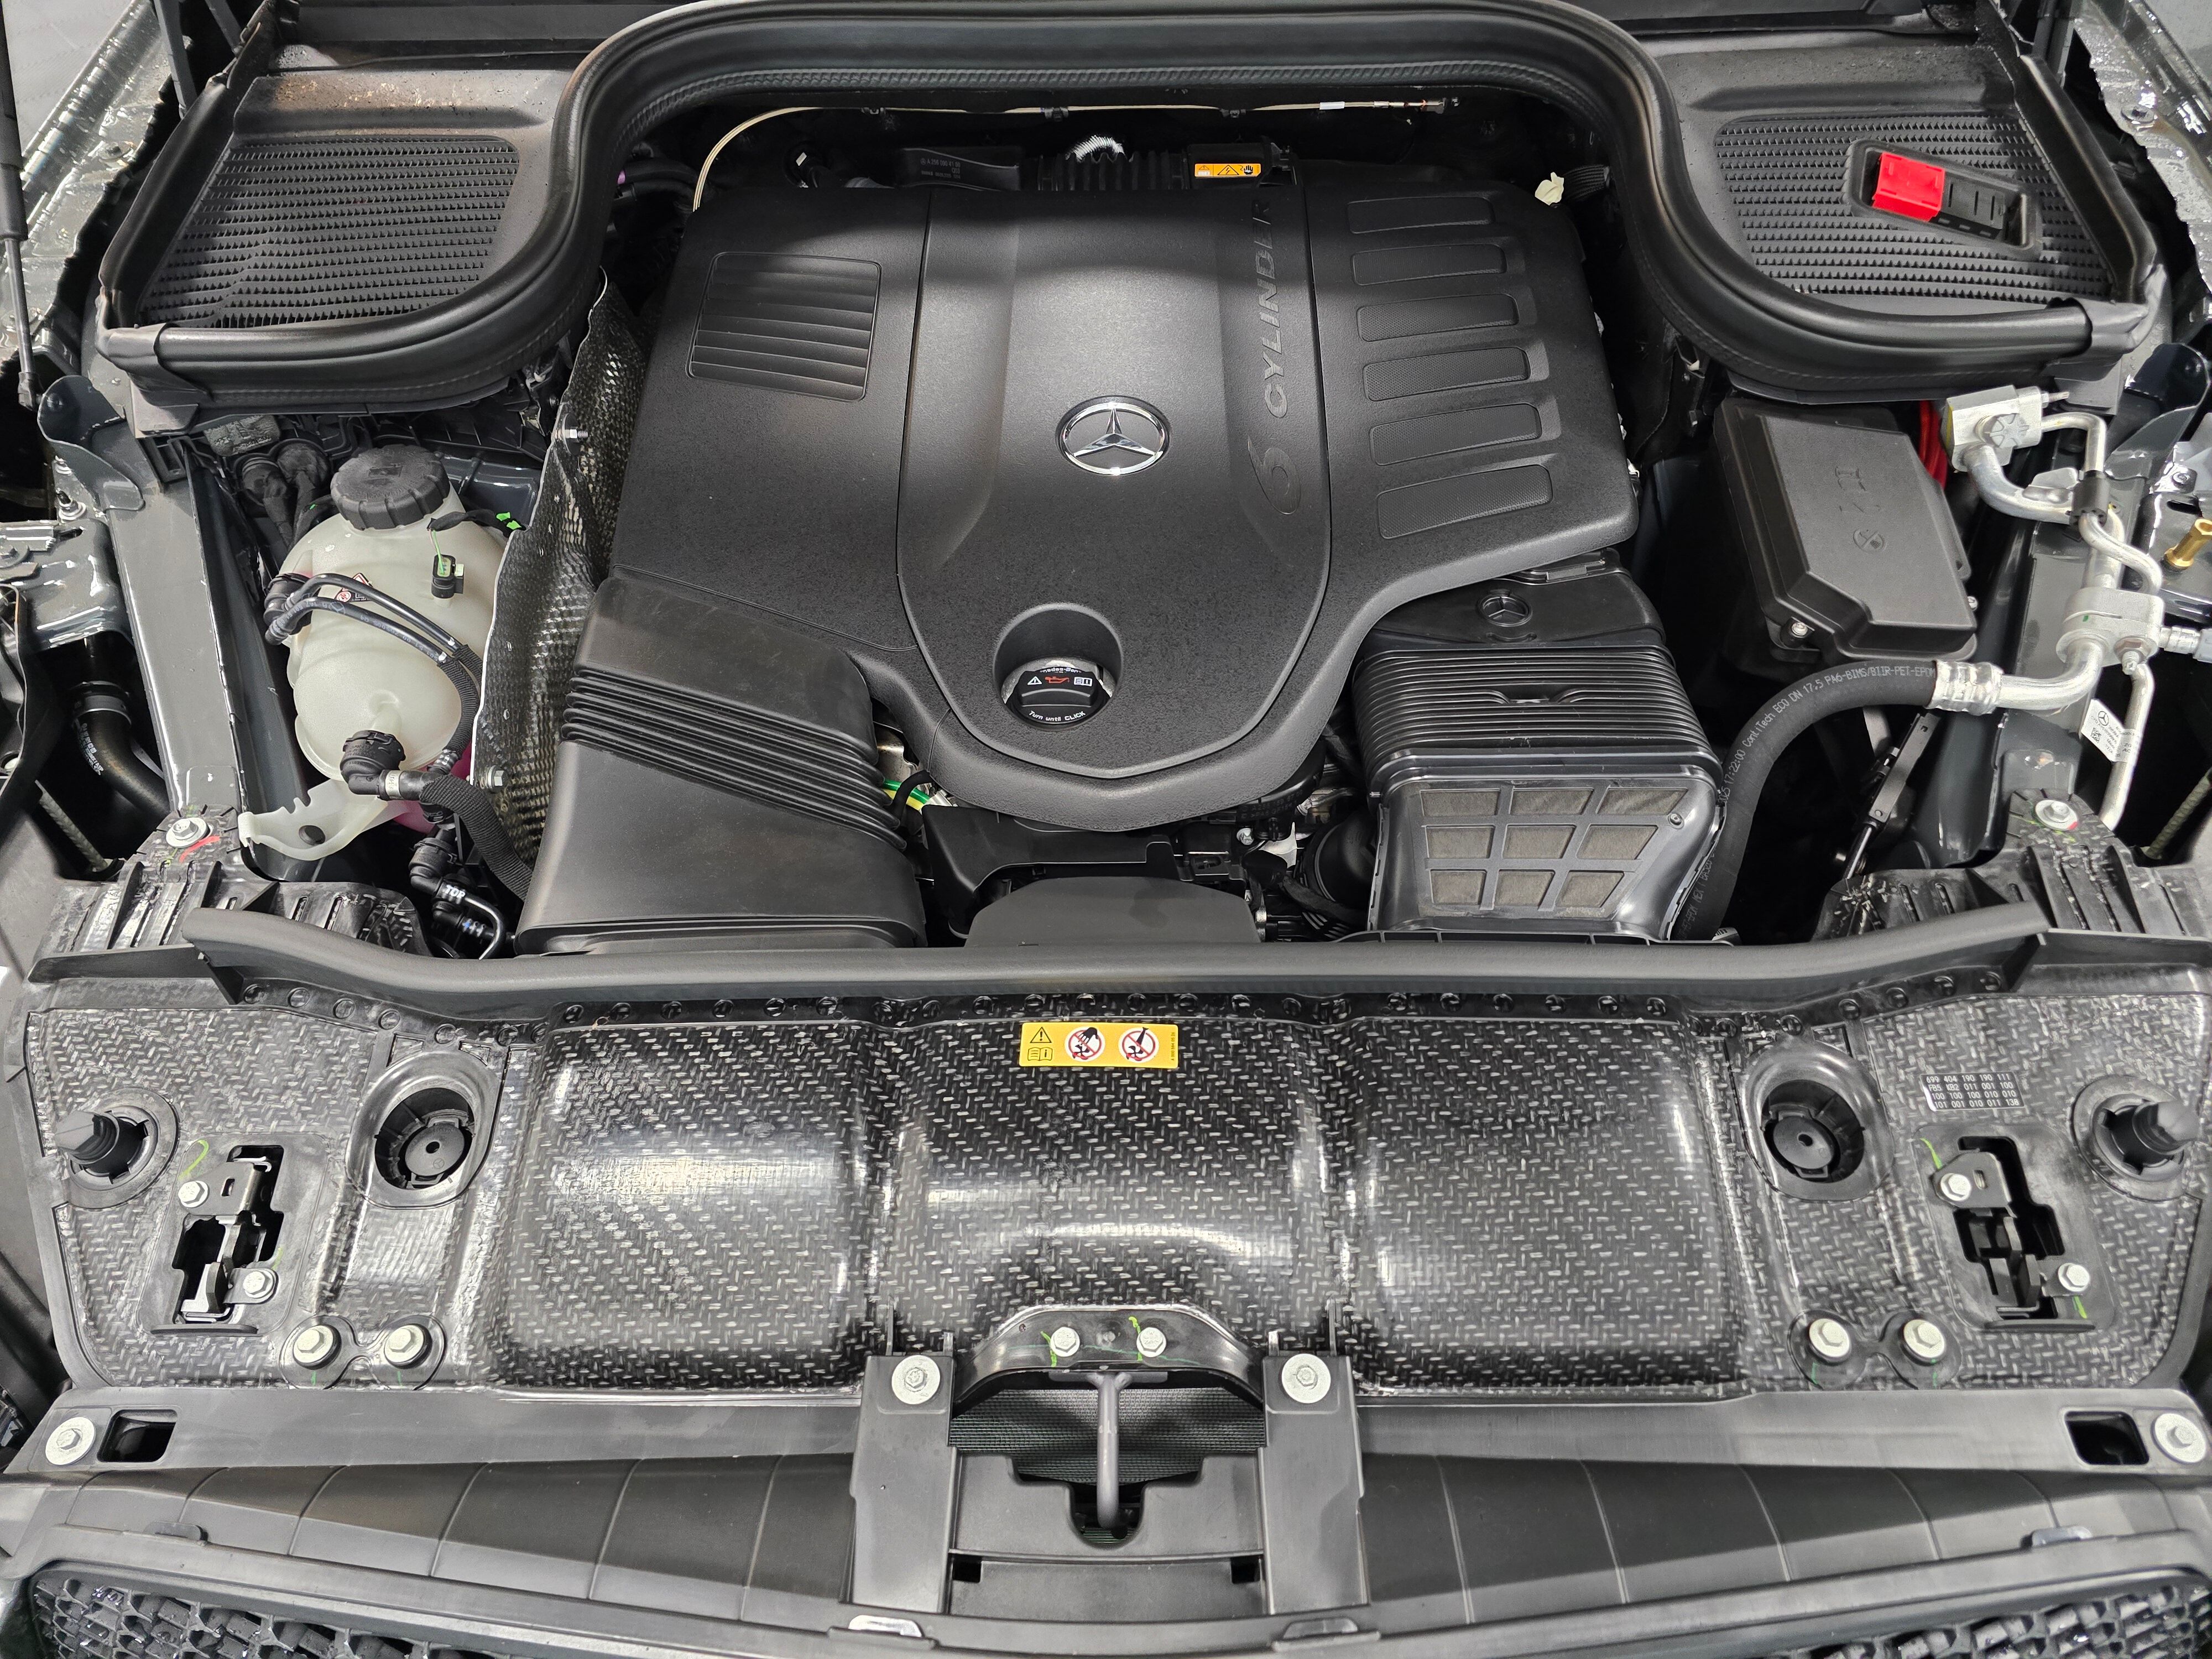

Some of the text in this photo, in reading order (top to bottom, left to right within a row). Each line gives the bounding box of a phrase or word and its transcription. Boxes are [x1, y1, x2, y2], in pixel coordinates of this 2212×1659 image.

[1248, 200, 1301, 515] 6 CYLINDER
[1029, 710, 1044, 720] Turn
[1064, 711, 1087, 721] CLICK
[1724, 749, 1746, 785] 17:22:00
[1742, 713, 1776, 748] ContiTech
[1772, 698, 1790, 713] ECO
[1788, 690, 1803, 702] DN
[1803, 679, 1824, 693] 17.5
[445, 884, 466, 898] TOP
